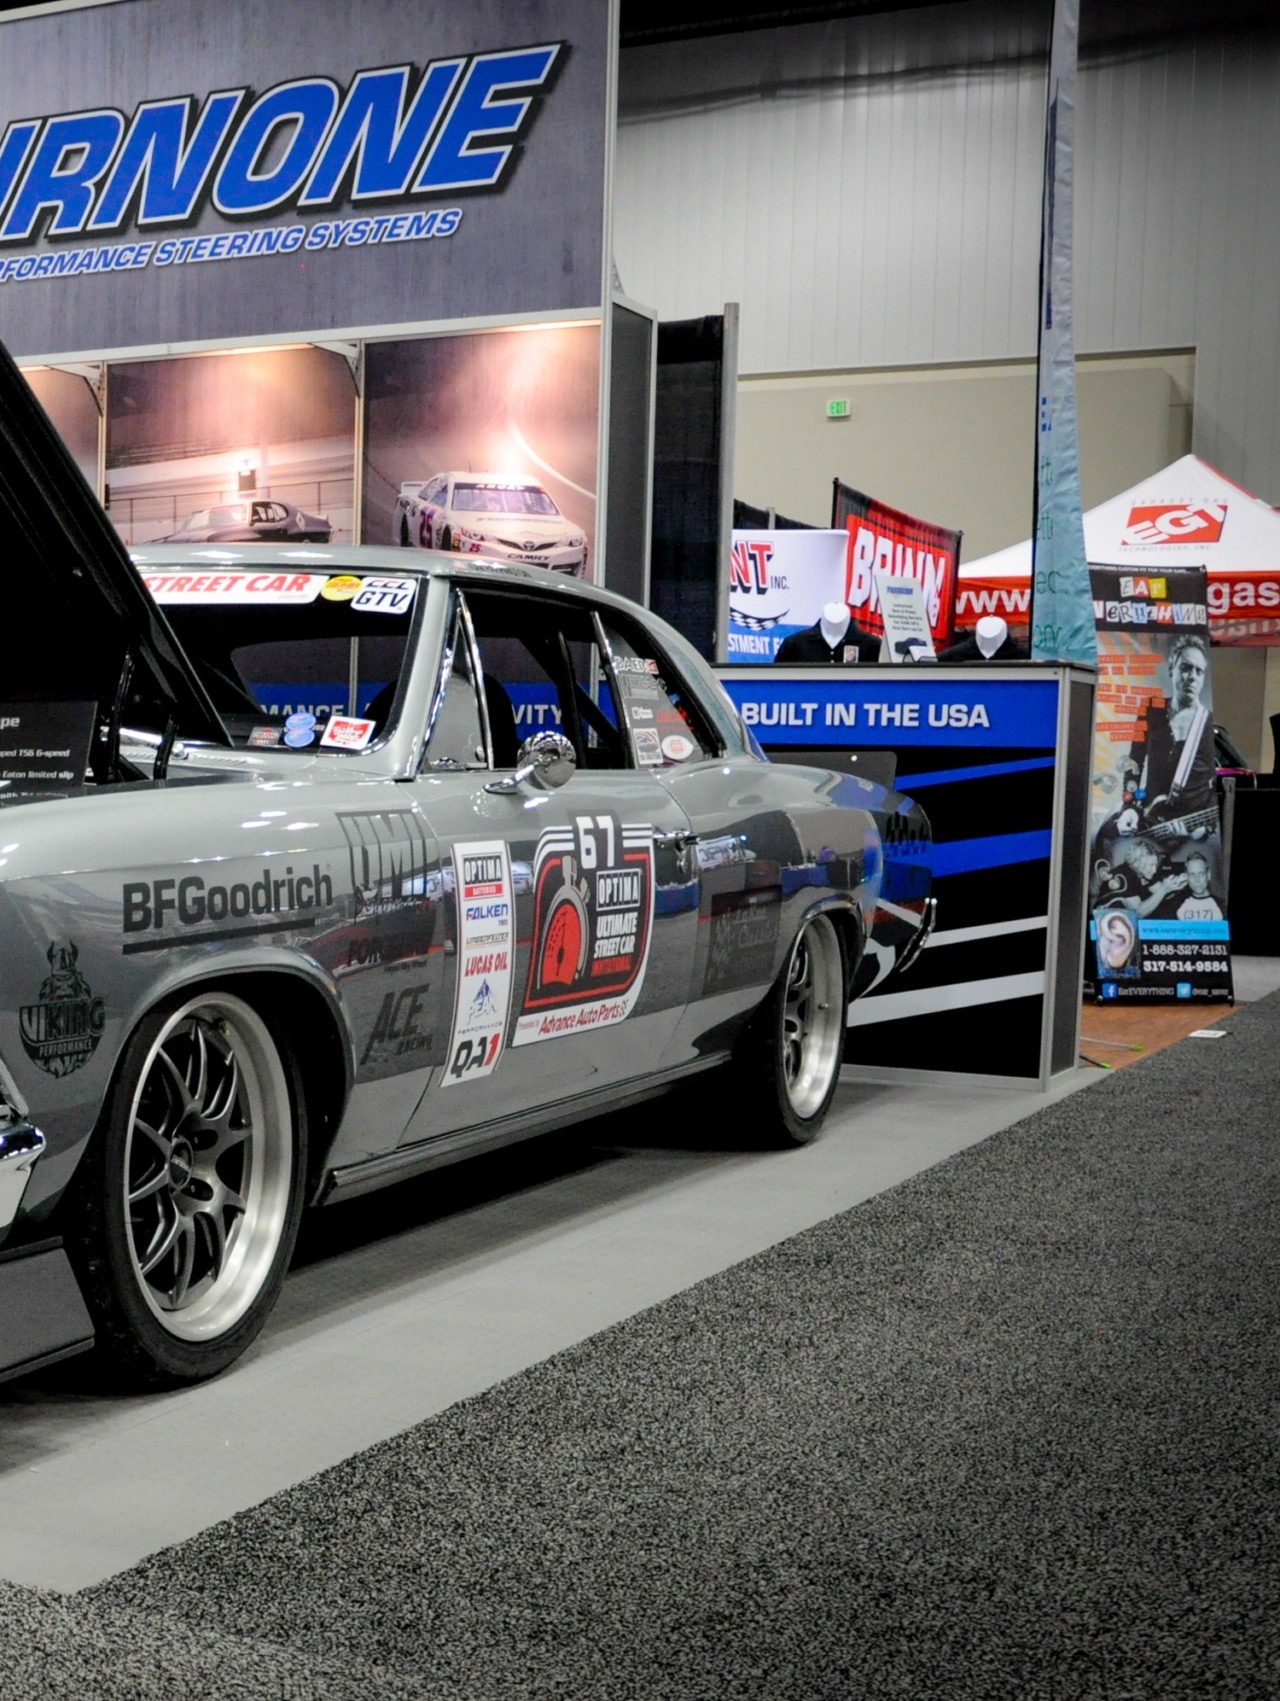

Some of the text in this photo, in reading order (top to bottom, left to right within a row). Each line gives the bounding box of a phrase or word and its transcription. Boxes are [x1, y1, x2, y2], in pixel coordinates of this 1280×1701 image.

[155, 225, 309, 267] STEERING
[305, 208, 462, 249] SYSTEMS
[830, 400, 848, 415] EXIT
[507, 553, 550, 561] CAMRY
[144, 575, 240, 592] STREET
[245, 574, 312, 592] CAR
[355, 590, 410, 608] GTV
[1207, 581, 1280, 615] gas
[741, 702, 990, 728] BUILT IN THE USA
[19, 749, 34, 757] T56
[36, 749, 70, 758] 6-speed
[28, 771, 57, 779] limited
[58, 771, 74, 780] slip
[576, 815, 614, 869] 67
[464, 857, 502, 882] OPTIMA
[122, 864, 333, 933] BFGoodrich
[472, 886, 496, 896] BATTERIES
[599, 875, 638, 904] OPTIMA
[466, 904, 508, 921] FALKEN
[1183, 909, 1213, 920] (317)
[596, 912, 638, 938] ULTIMATE
[594, 935, 635, 959] STREET CAR
[1142, 944, 1228, 956] 1-888-327-2131
[464, 951, 508, 977] LUCAS OIL
[1143, 960, 1229, 972] 317-514-9584
[19, 996, 106, 1045] VIKING
[359, 984, 429, 1066] ACE
[538, 1002, 621, 1036] Advance Auto Parts
[40, 1038, 93, 1058] PERFORMANCE
[451, 1033, 500, 1078] QA1
